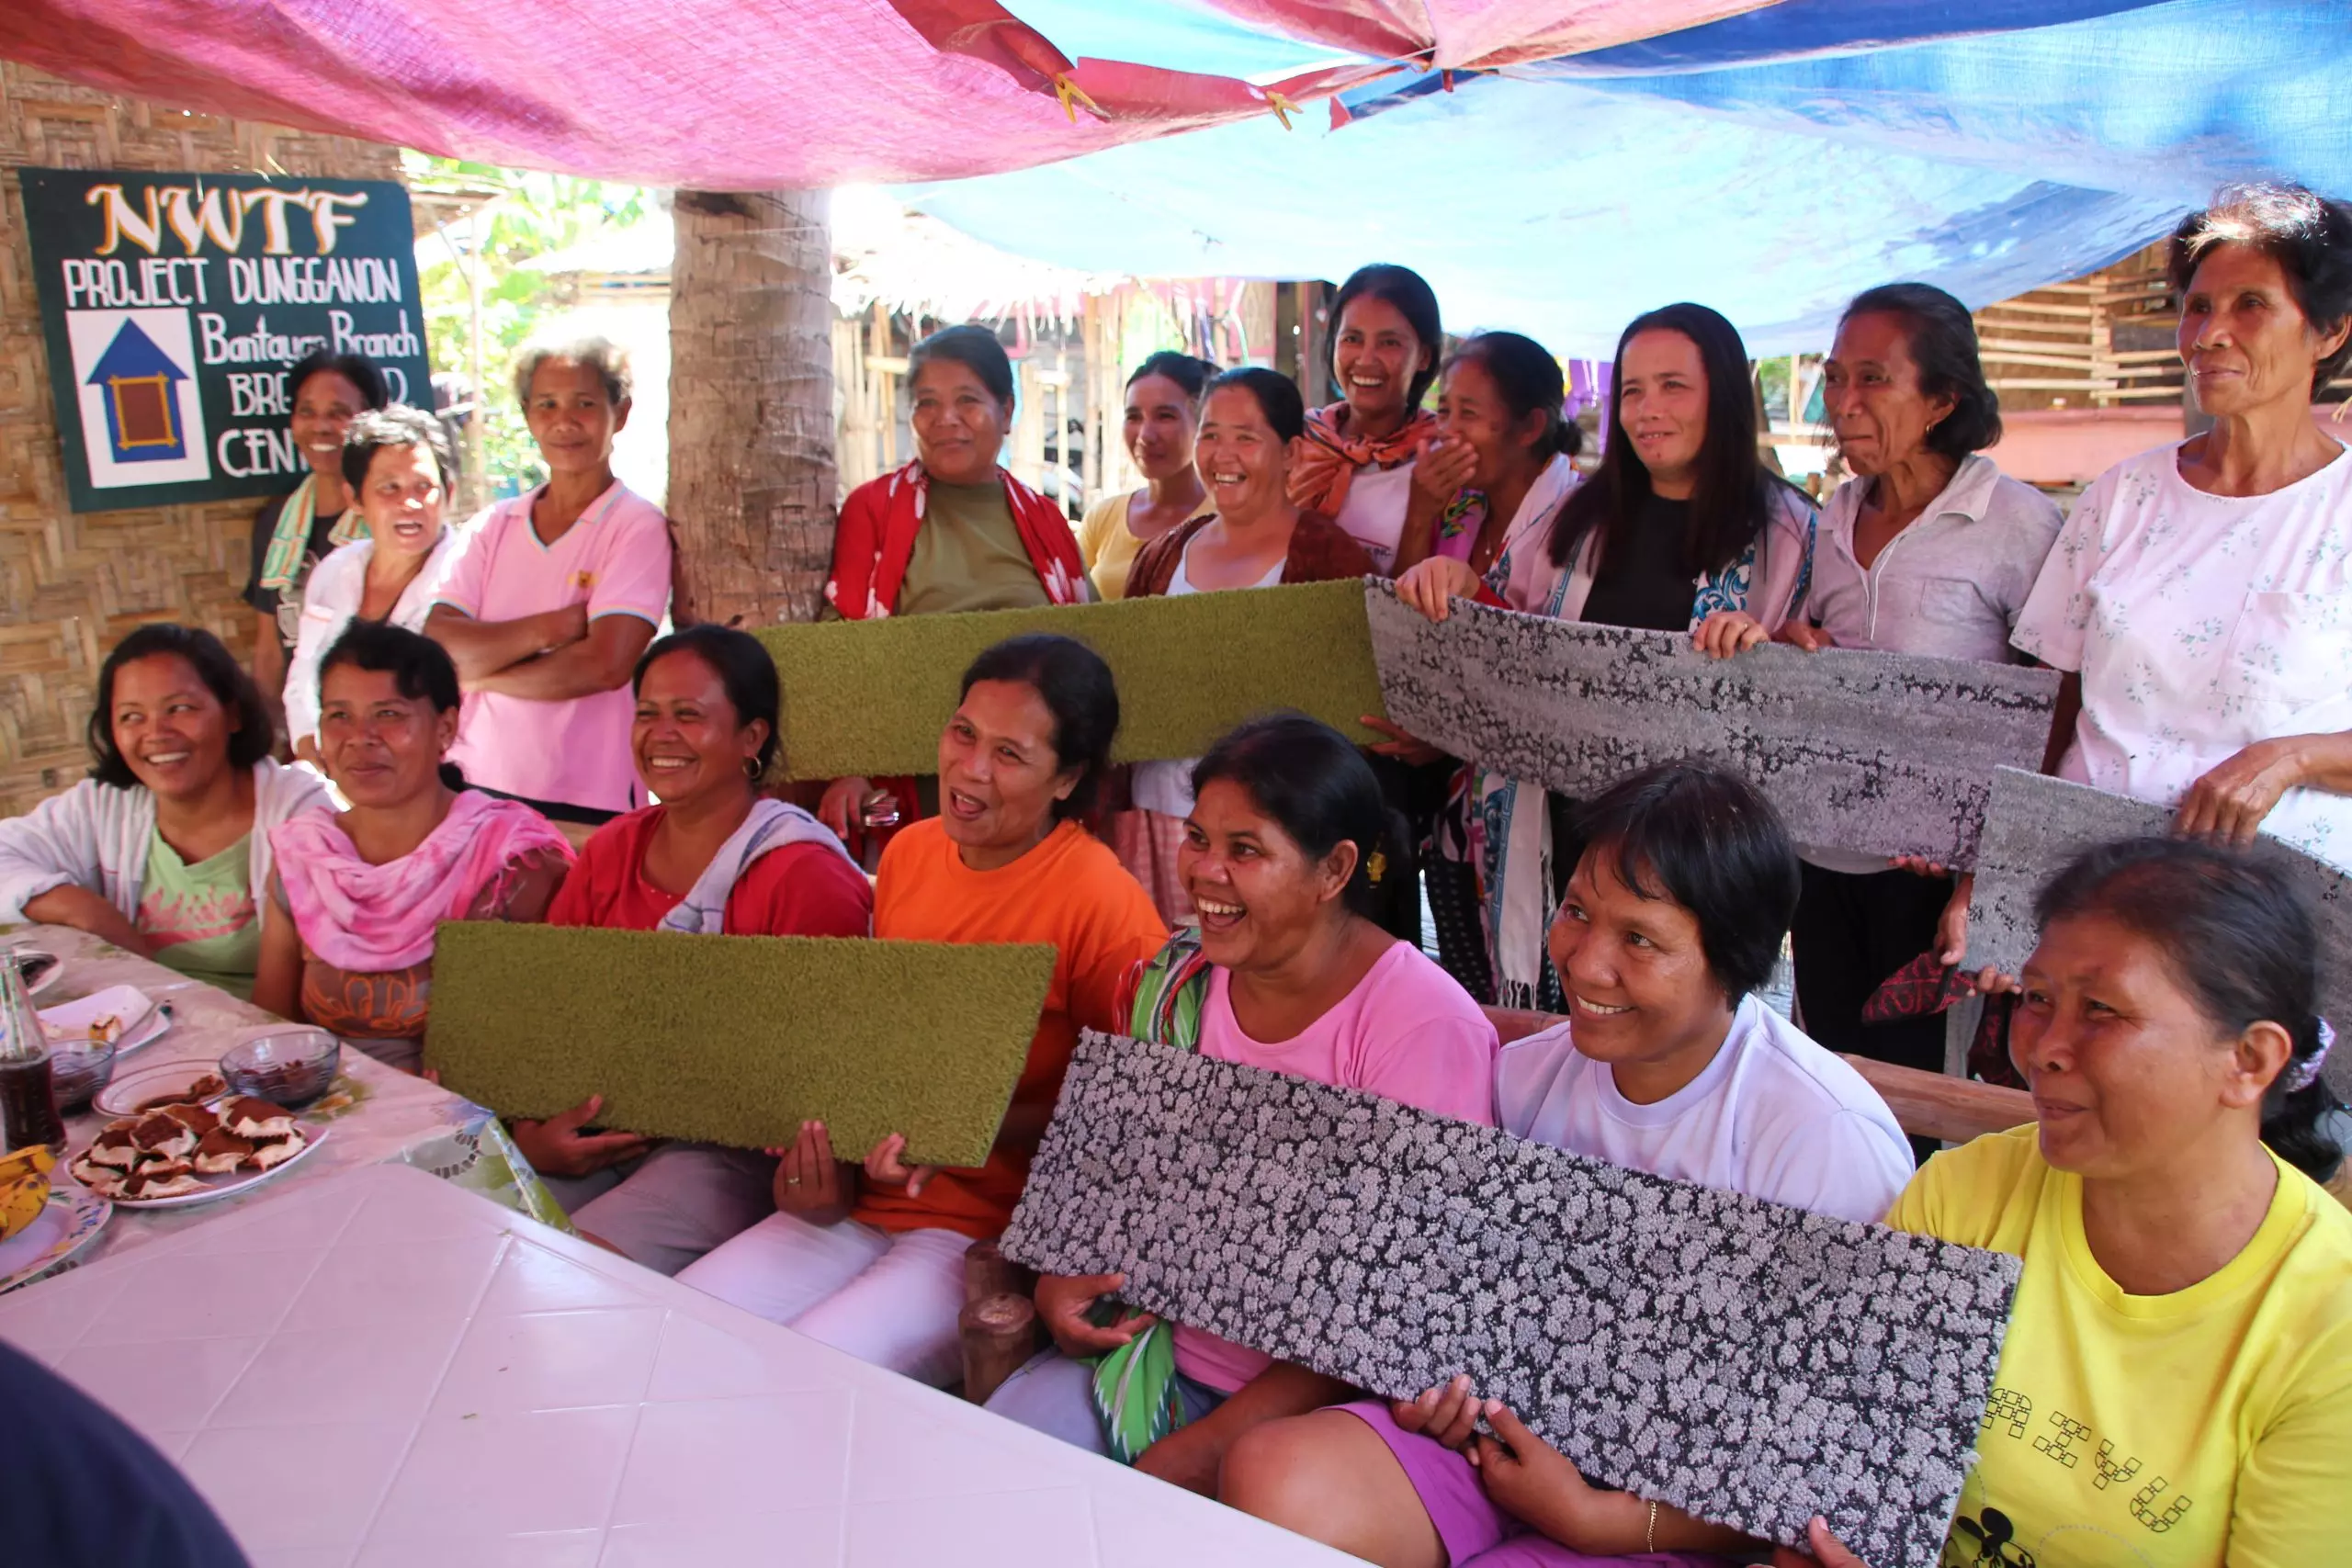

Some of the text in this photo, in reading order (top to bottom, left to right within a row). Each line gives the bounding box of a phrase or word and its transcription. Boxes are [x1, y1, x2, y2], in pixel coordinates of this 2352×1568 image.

[86, 185, 368, 254] NWTF
[62, 258, 401, 307] PROJECT DUNGGANON
[328, 309, 420, 358] Branch
[218, 427, 309, 478] CEN
